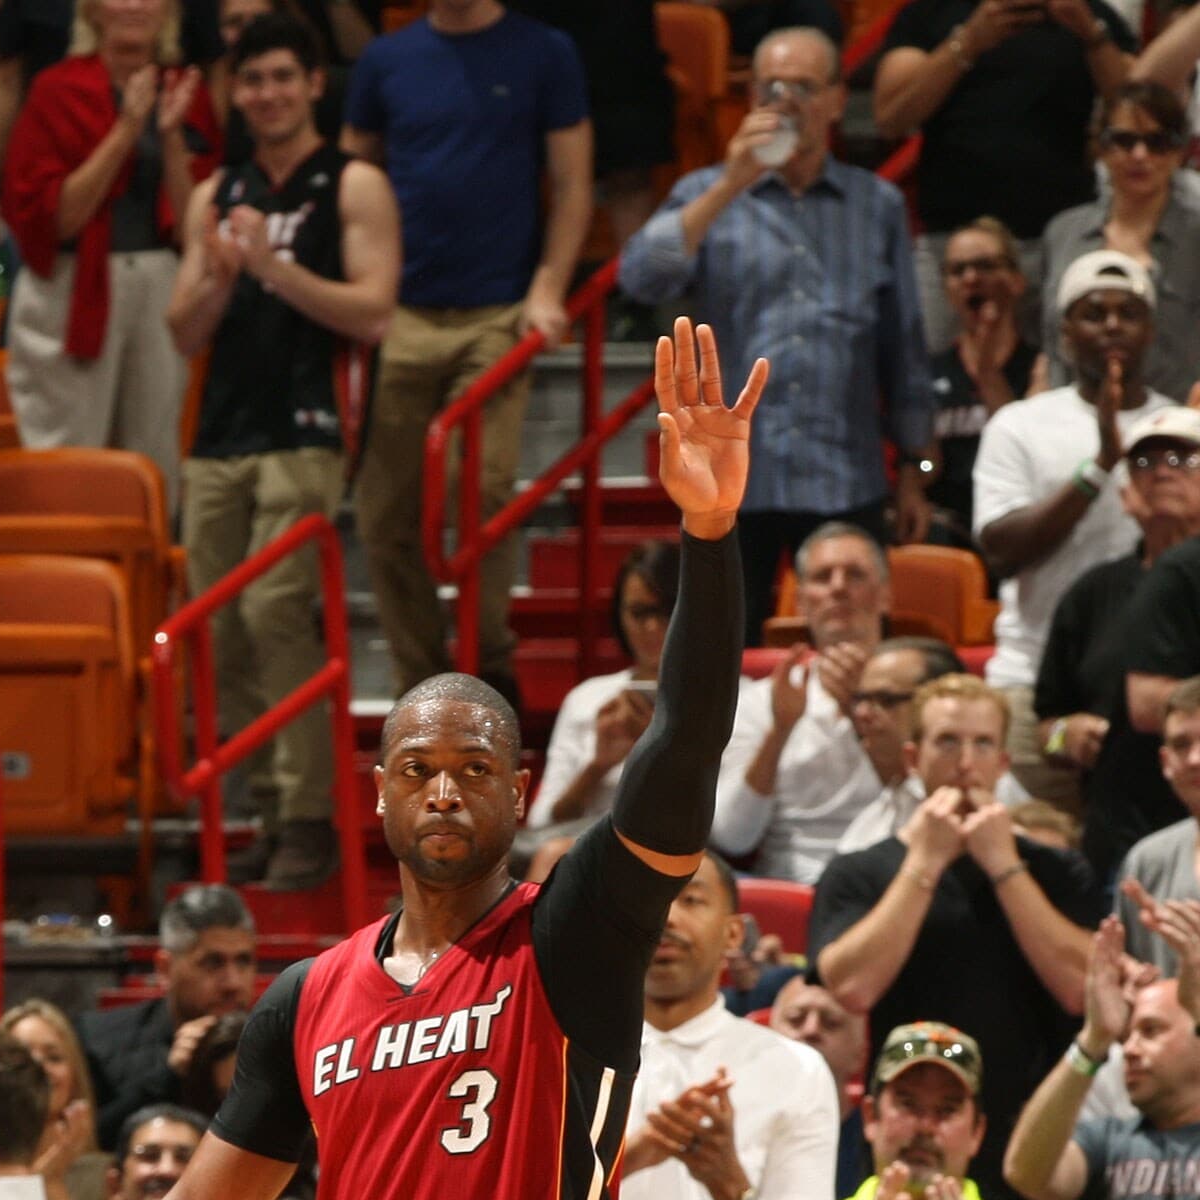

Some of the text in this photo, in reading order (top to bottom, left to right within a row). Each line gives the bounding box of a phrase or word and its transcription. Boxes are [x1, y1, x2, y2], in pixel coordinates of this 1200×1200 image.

[313, 983, 513, 1097] EL HEAT
[440, 1066, 499, 1155] 3
